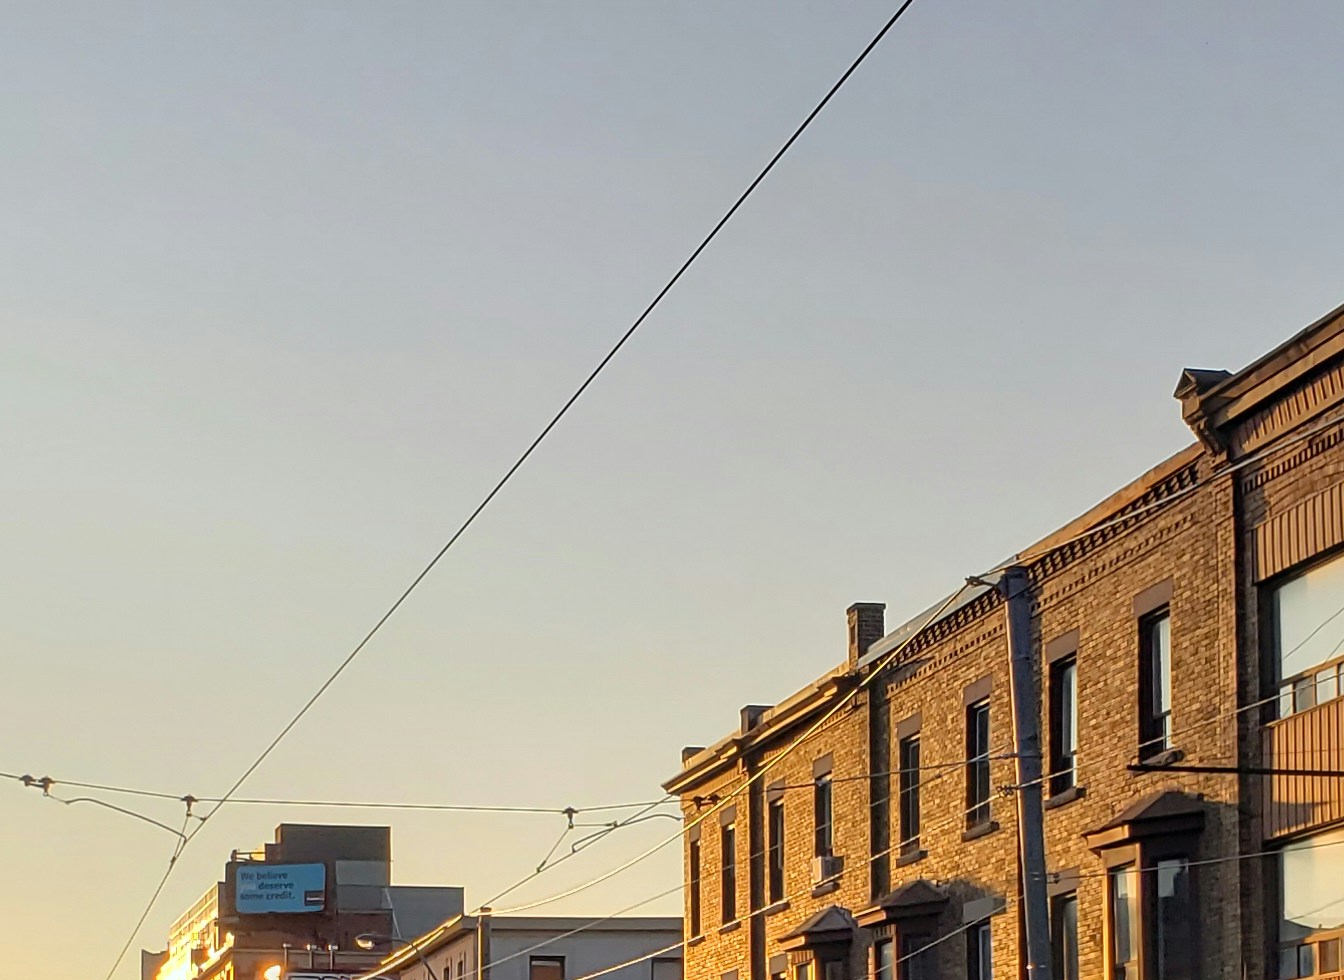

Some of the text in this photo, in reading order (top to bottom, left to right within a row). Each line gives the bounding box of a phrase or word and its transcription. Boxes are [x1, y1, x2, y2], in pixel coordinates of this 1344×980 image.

[256, 872, 288, 880] believe
[258, 882, 294, 890] deserve
[240, 892, 264, 900] some
[266, 891, 296, 900] credit.
